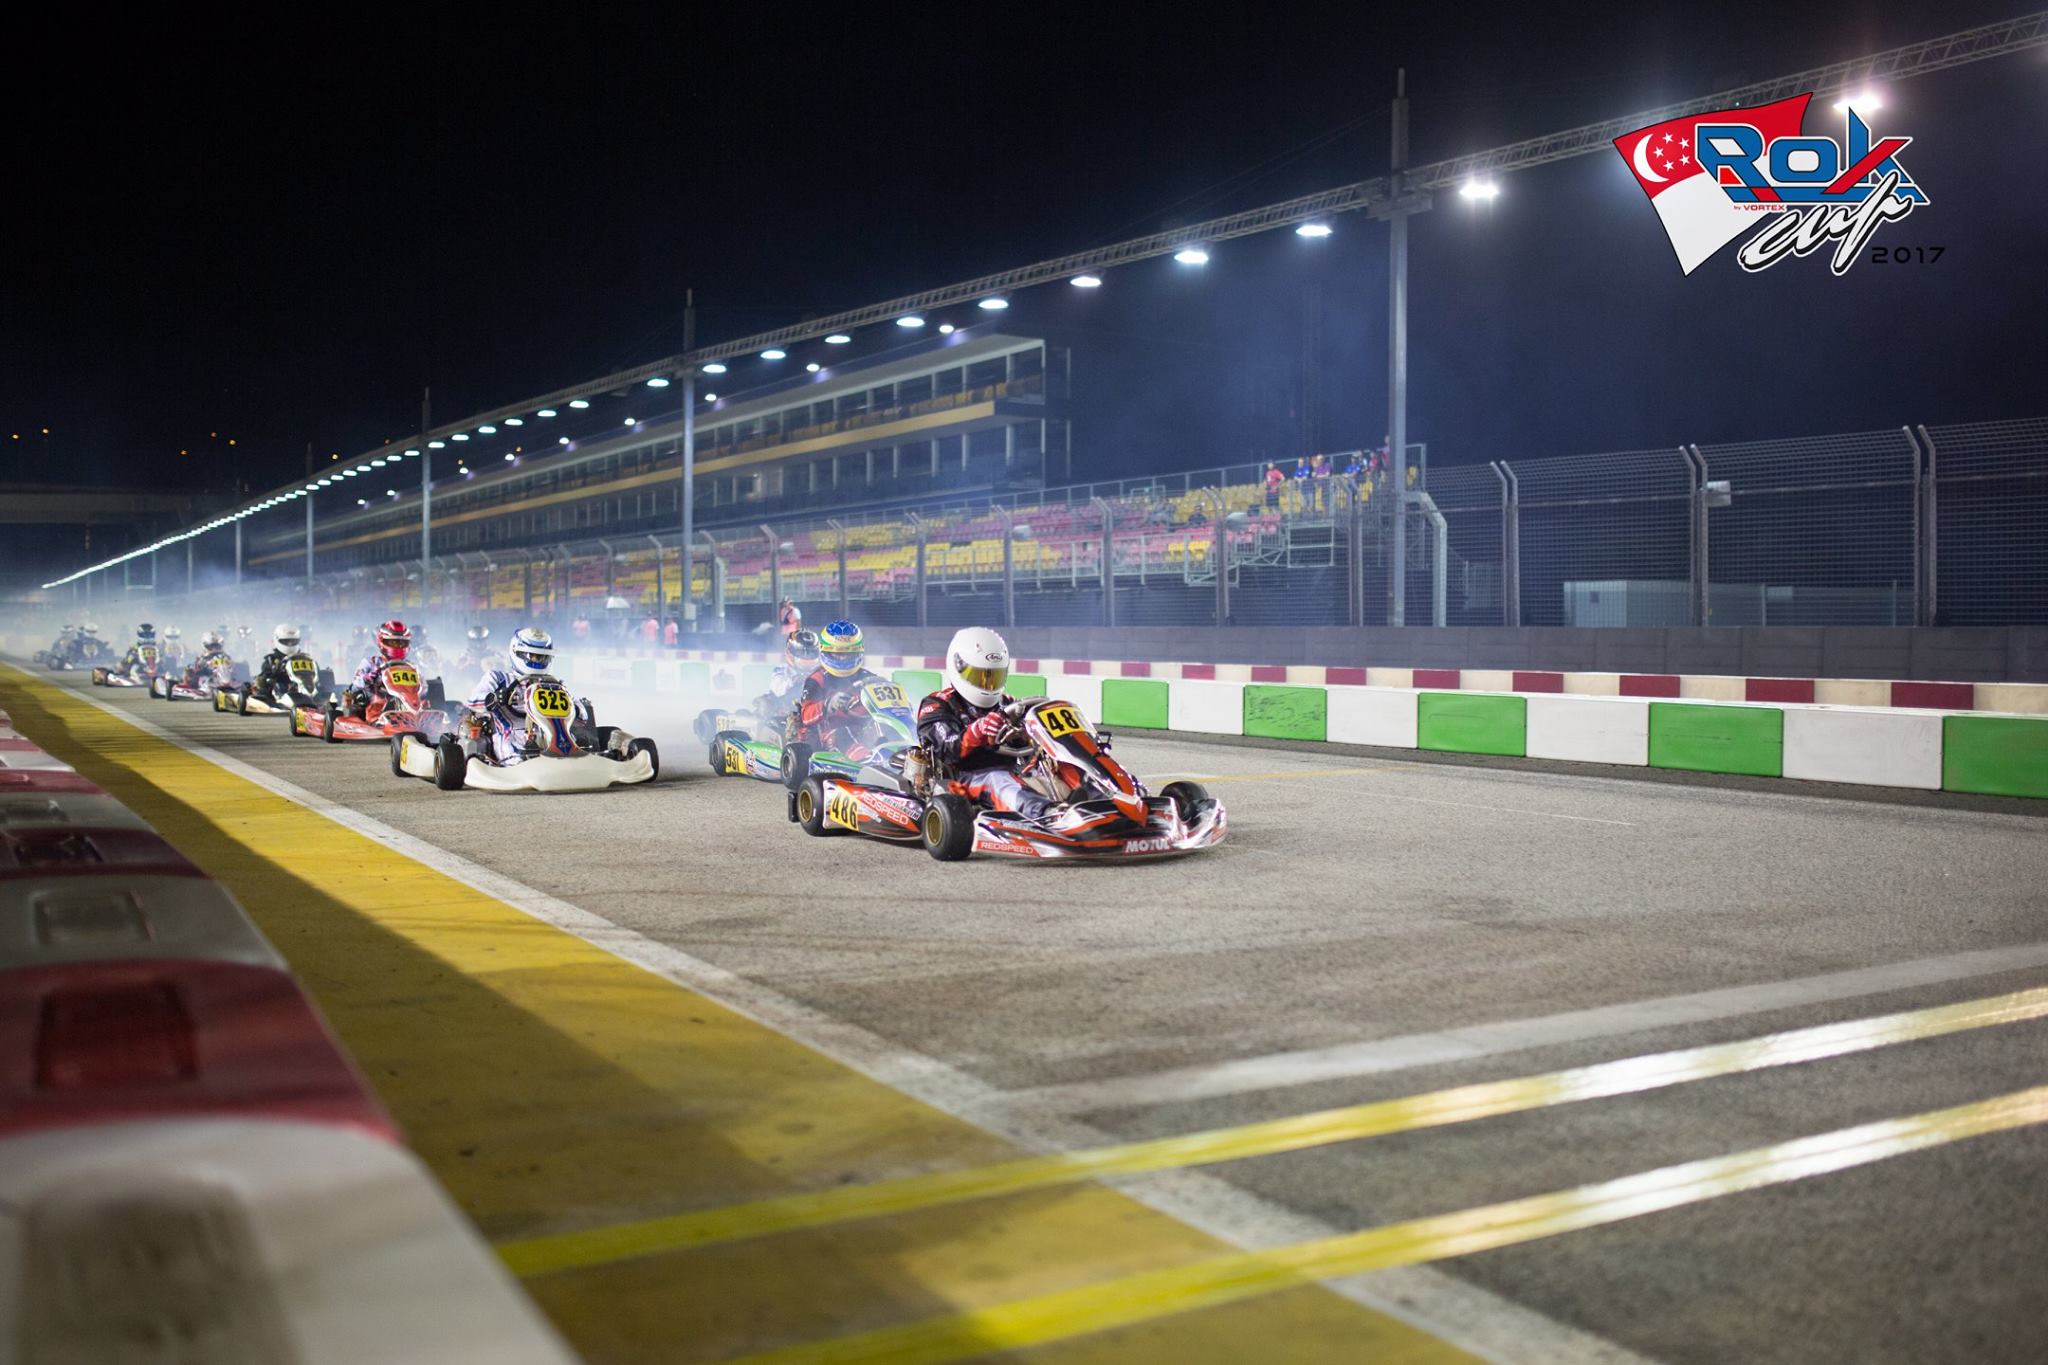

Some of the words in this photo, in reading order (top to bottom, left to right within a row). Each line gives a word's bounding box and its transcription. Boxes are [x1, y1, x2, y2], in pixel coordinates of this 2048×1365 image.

[392, 672, 417, 683] 544
[538, 690, 569, 711] 525
[873, 686, 903, 701] 537
[832, 796, 858, 829] 486
[981, 841, 1034, 854] REDSPEED
[1125, 840, 1170, 853] MOTUL
